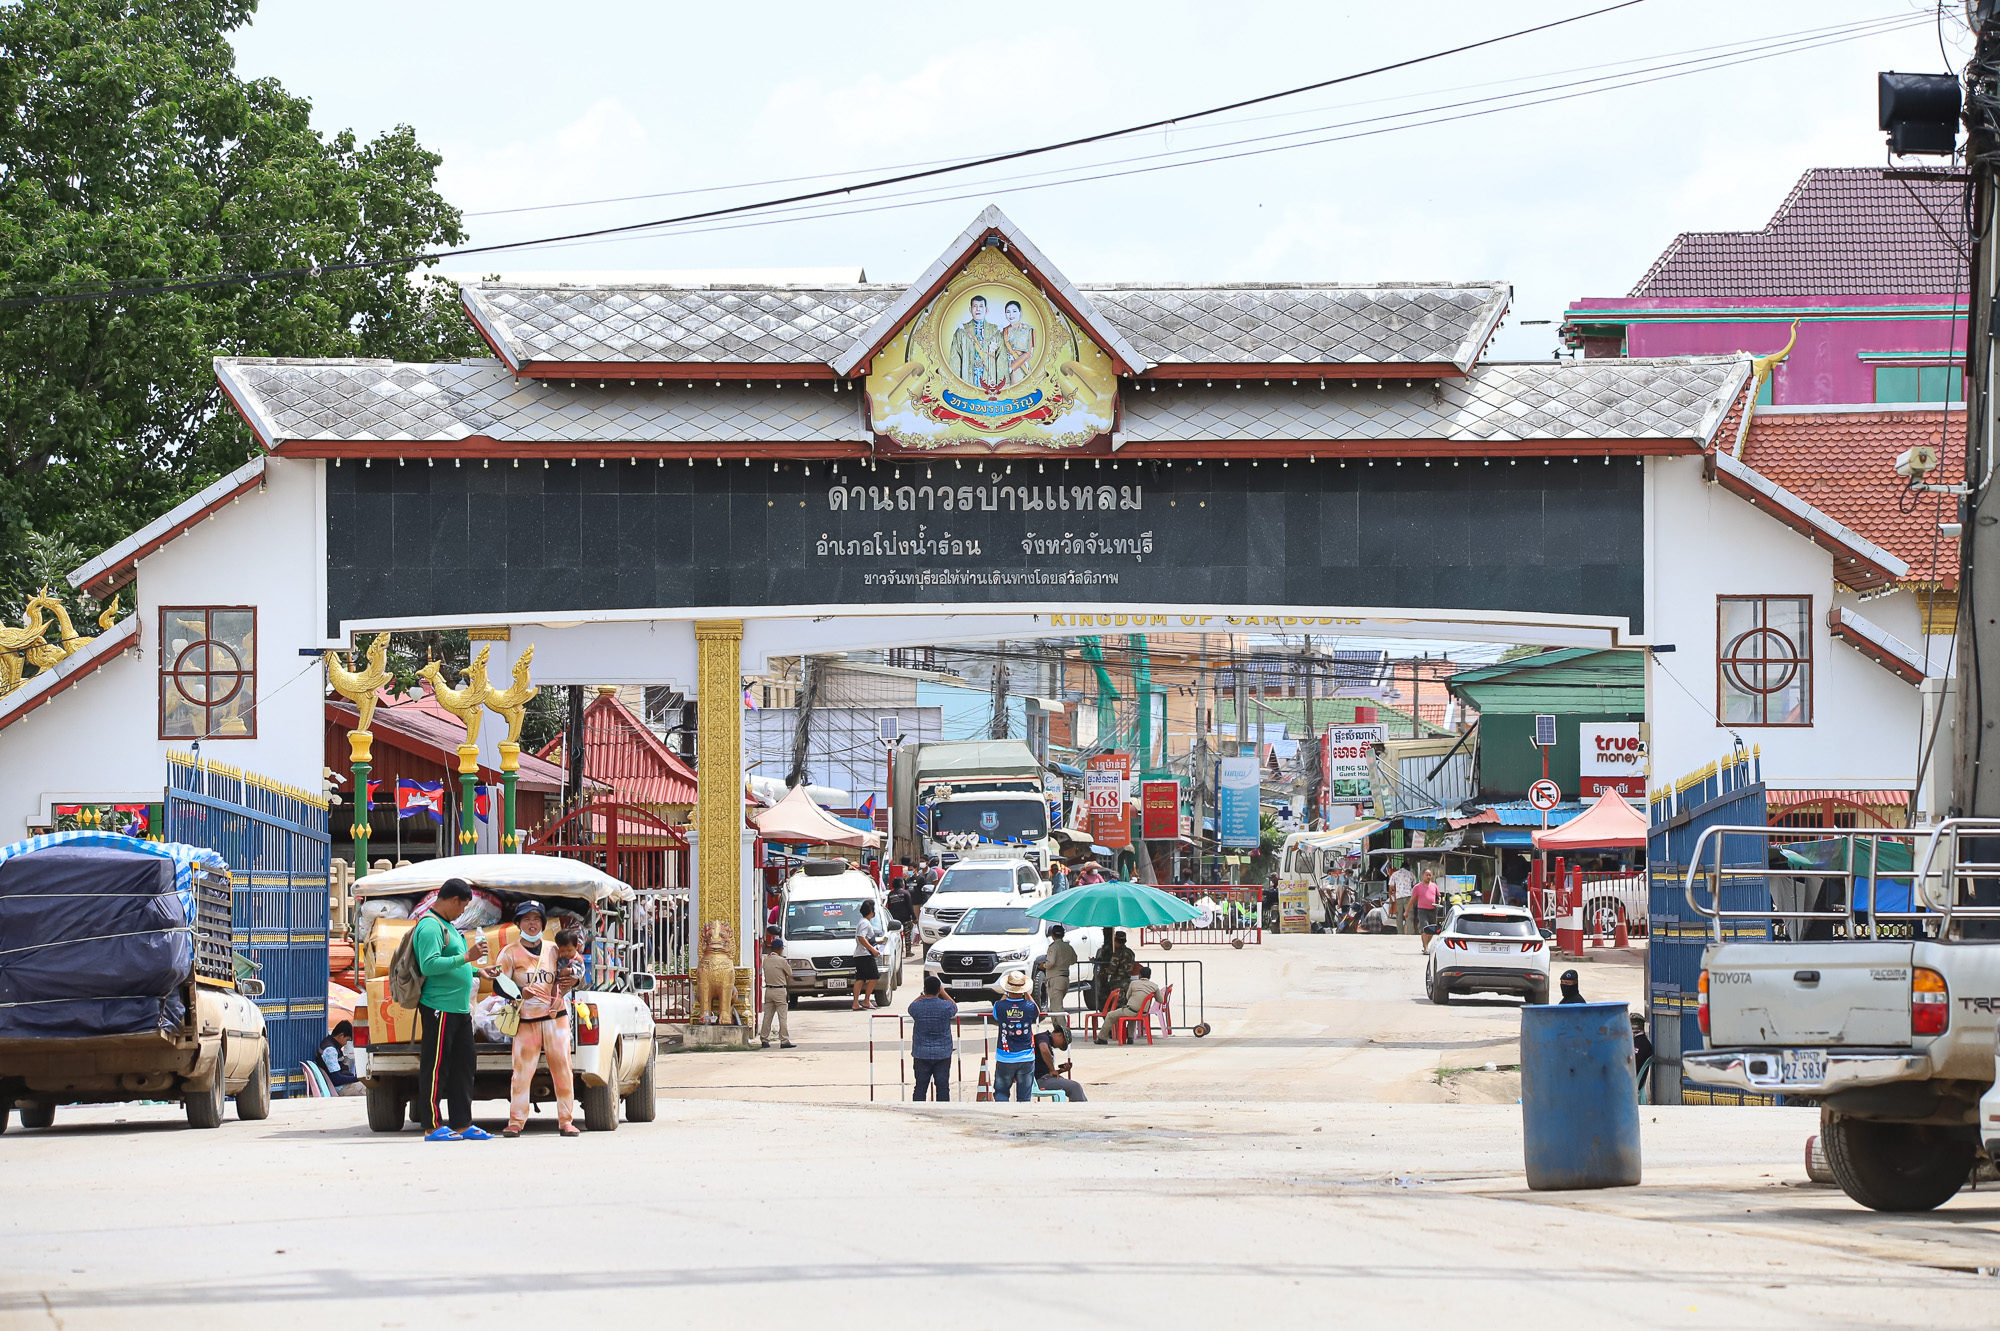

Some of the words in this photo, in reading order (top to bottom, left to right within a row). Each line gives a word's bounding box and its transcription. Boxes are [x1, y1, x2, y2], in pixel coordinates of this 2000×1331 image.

[950, 396, 1035, 414] ทรงพระเจริญ
[828, 472, 1142, 511] ด่านถาวรบ้านแหลม
[816, 524, 982, 556] อำเภอโป่งน้ำร้อน
[1021, 531, 1153, 563] จังหวัดจันทบุรี
[864, 569, 1119, 590] ชาวจันทบุรีขอให้ท่านเดินทางโดยสวัสดิภาพ
[1051, 614, 1168, 626] KINGDOM
[1180, 615, 1213, 626] OF
[1595, 735, 1639, 750] true
[1597, 753, 1638, 766] money
[1088, 790, 1119, 808] 168
[525, 972, 557, 984] DIO
[1712, 972, 1753, 984] TOYOTA
[1869, 969, 1907, 977] TACOMA
[1785, 1062, 1826, 1080] 2Z-583
